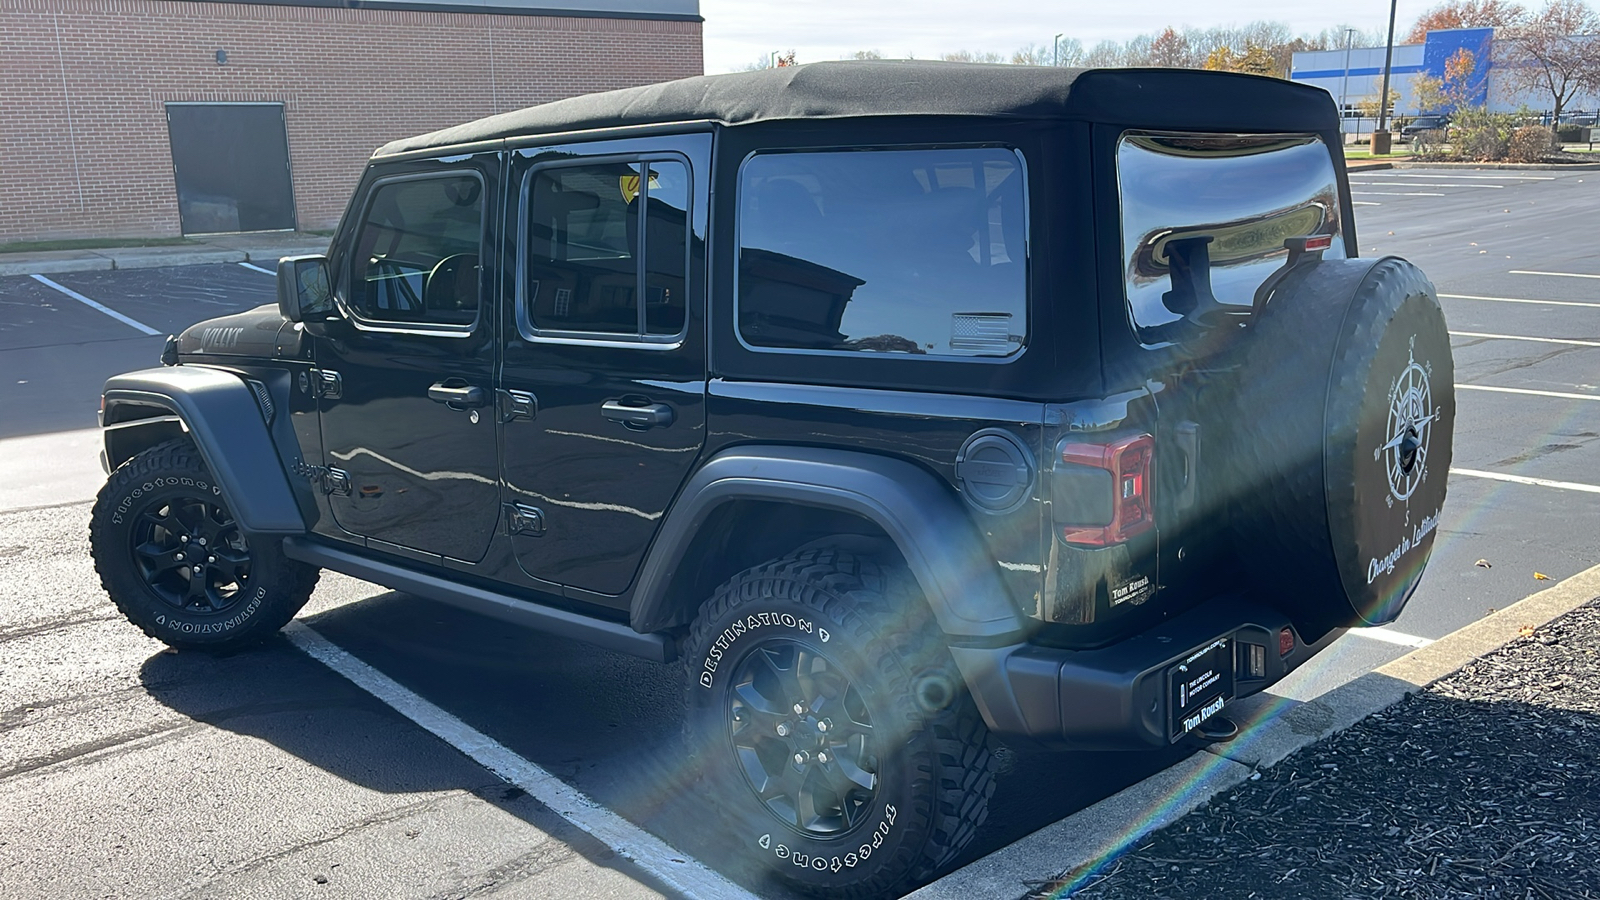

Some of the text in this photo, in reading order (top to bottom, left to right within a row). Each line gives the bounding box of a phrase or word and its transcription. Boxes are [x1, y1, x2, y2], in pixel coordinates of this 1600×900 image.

[112, 477, 208, 524] Firestone
[1404, 510, 1410, 527] S
[1367, 544, 1401, 584] Changes
[1402, 536, 1411, 555] in
[1112, 575, 1149, 600] Tom Roush
[169, 587, 267, 634] DESTINATION
[699, 612, 812, 689] DESTINATION
[1189, 669, 1213, 688] THE LINCOLN
[1189, 673, 1220, 697] MOTOR COMPANY
[1183, 696, 1225, 733] Tom Roush
[775, 803, 897, 873] Firestone
